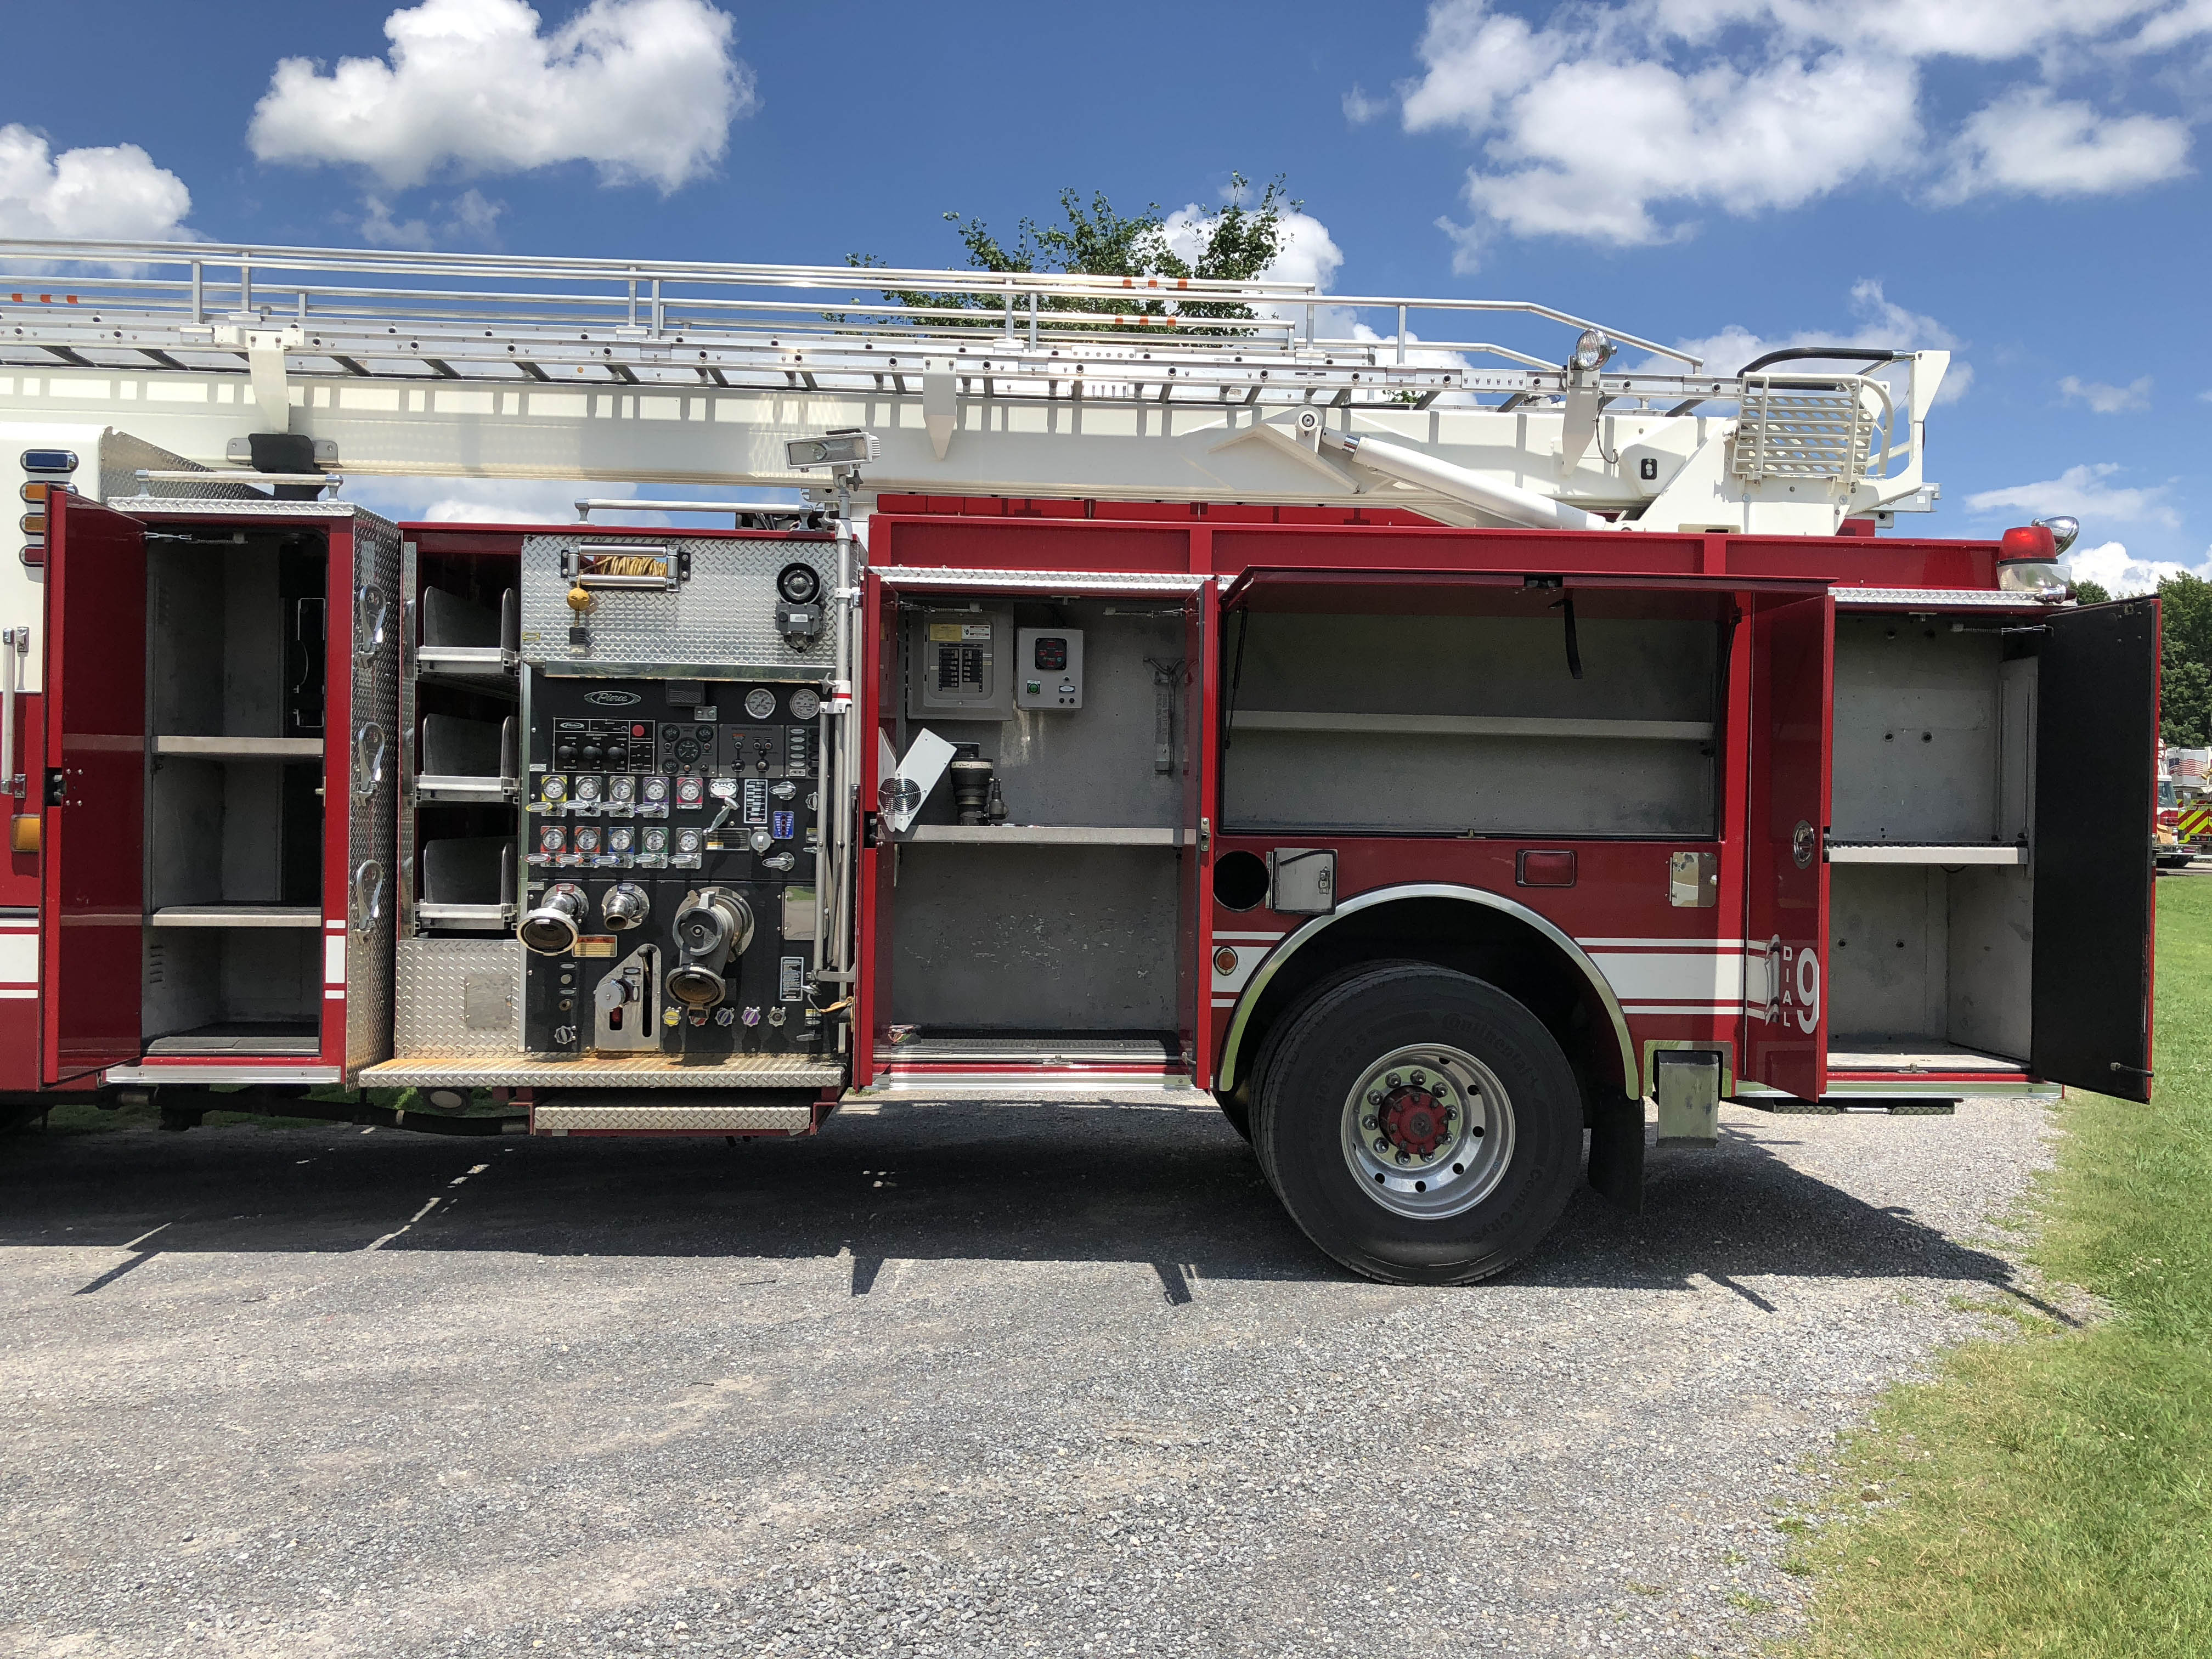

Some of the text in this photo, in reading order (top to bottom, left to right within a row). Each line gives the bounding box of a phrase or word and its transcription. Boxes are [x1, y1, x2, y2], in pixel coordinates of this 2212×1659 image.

[596, 692, 628, 703] Pierce
[1782, 946, 1819, 1034] DIAL 9
[1443, 1012, 1534, 1077] Continental
